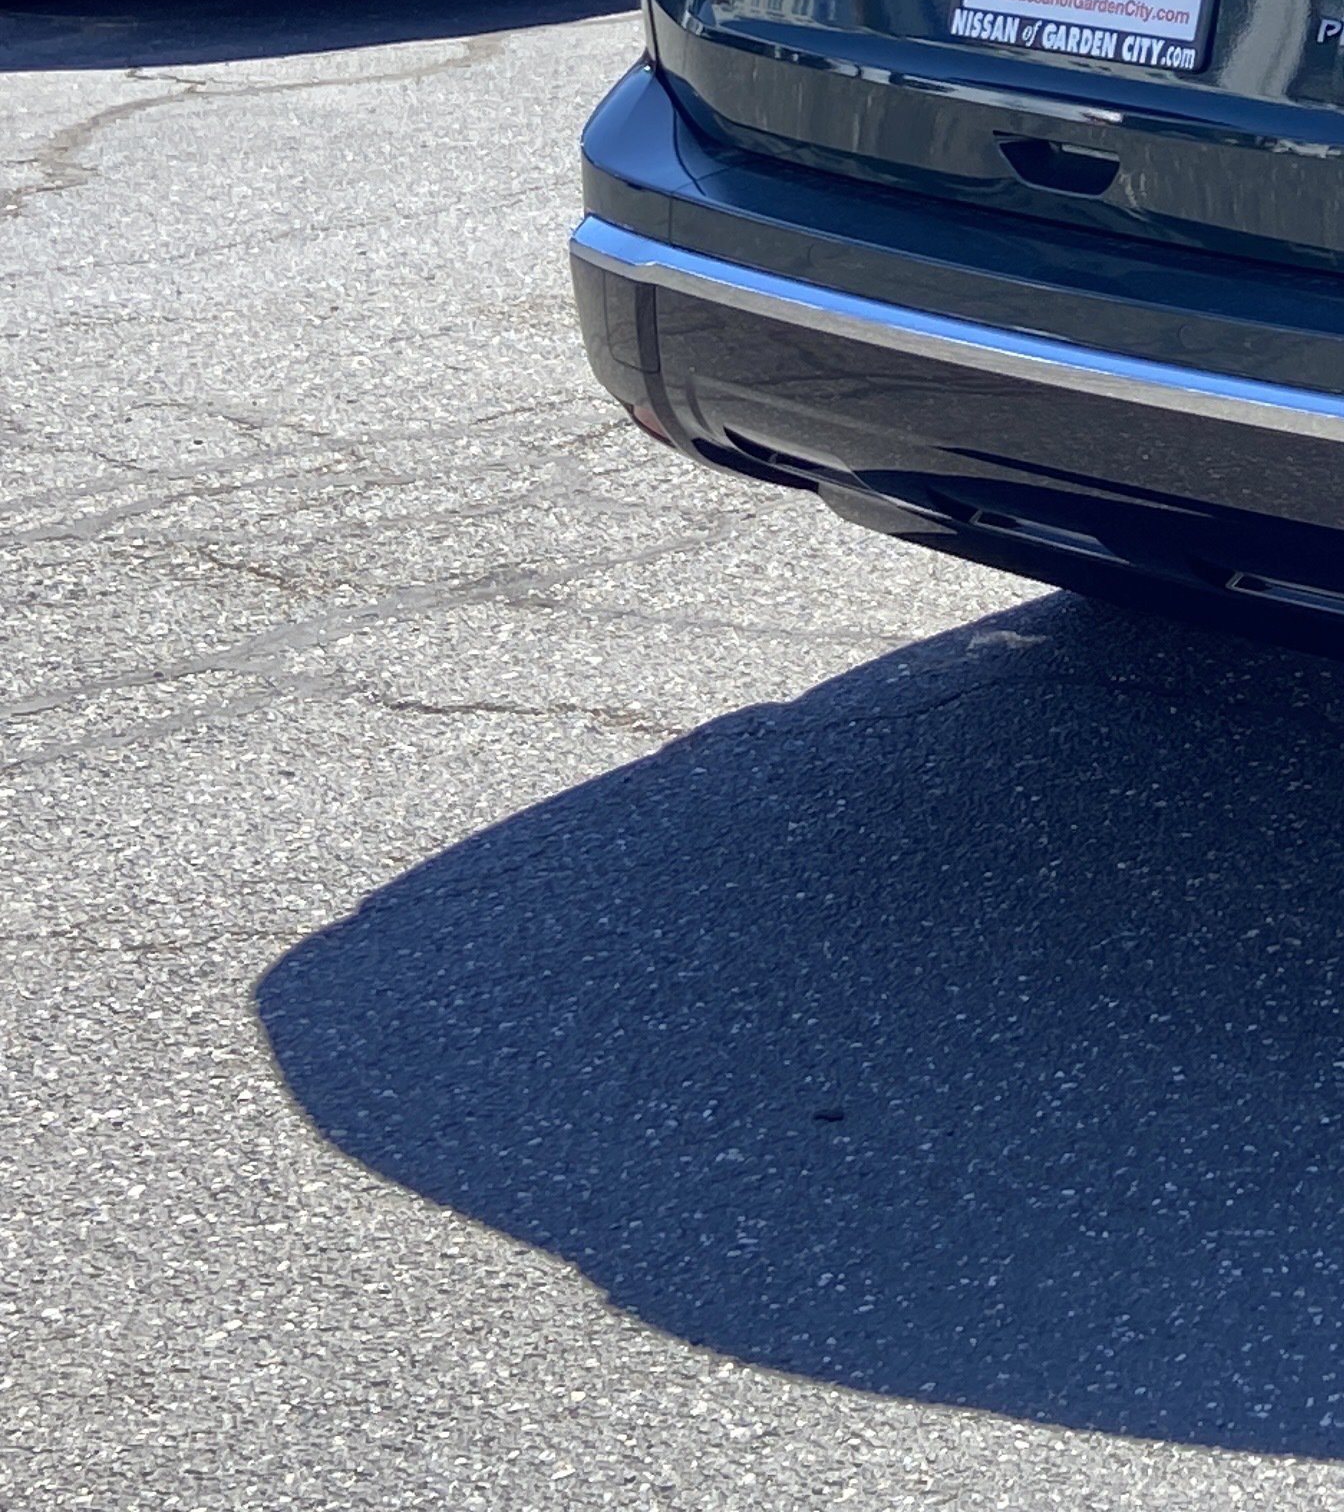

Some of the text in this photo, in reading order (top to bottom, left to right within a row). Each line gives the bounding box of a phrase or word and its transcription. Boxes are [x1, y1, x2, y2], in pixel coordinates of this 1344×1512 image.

[950, 8, 1196, 70] NISSAN of GARDEN CITY.com
